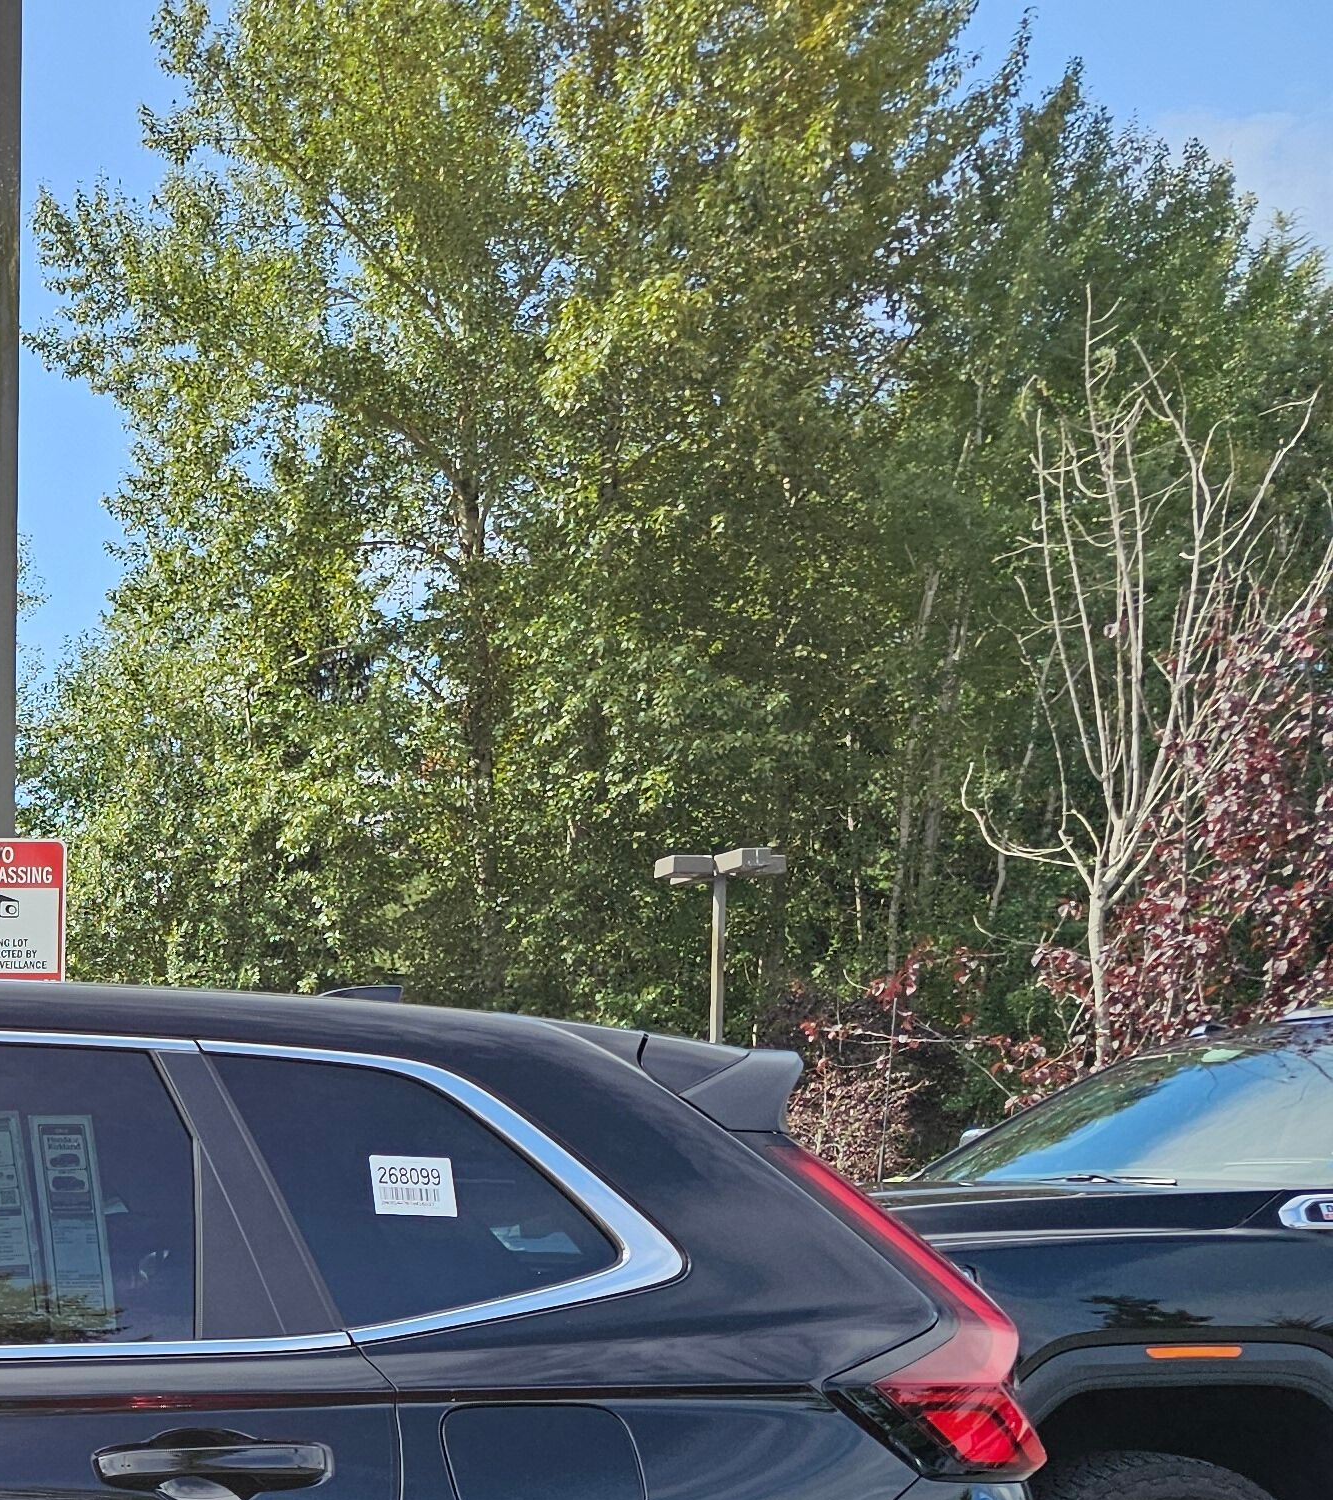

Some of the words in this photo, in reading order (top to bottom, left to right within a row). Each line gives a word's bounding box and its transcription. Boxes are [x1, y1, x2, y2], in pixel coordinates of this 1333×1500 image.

[12, 938, 29, 947] LOT
[25, 949, 37, 958] BY
[377, 1166, 441, 1186] 268099
